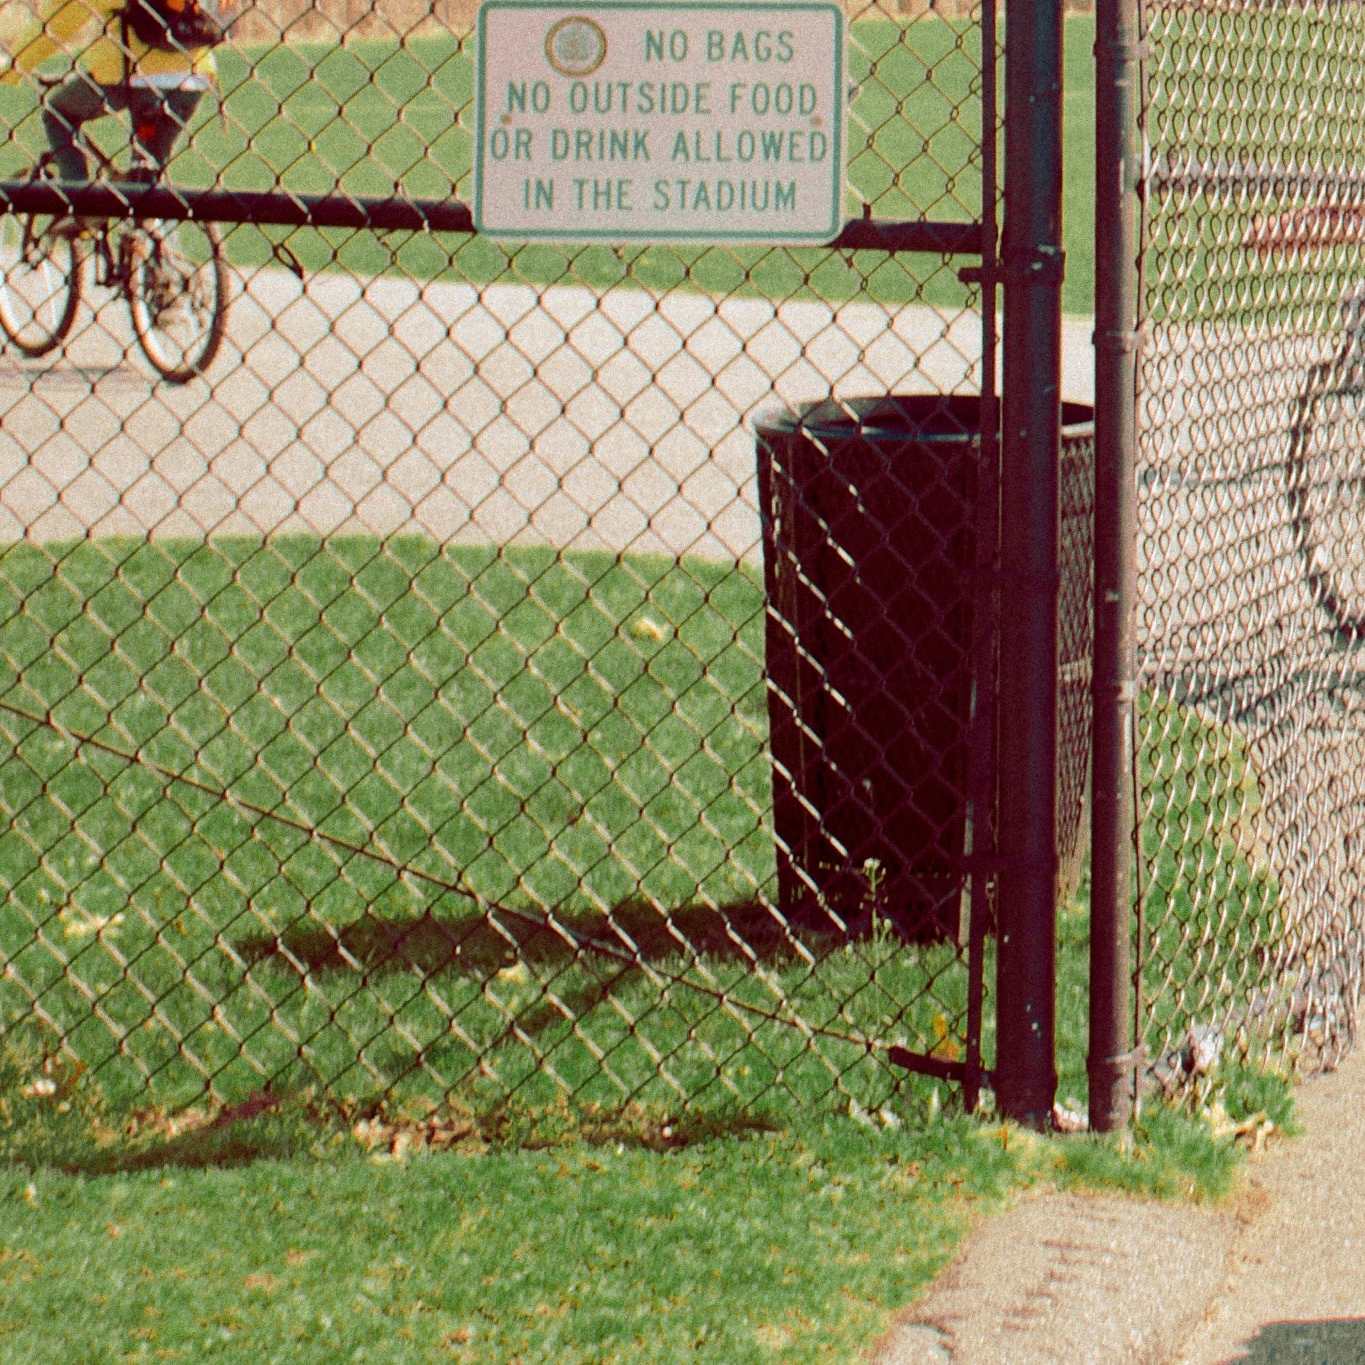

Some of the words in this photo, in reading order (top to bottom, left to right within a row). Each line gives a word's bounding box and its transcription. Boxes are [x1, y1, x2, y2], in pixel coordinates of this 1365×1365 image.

[645, 29, 688, 63] NO
[707, 30, 795, 64] BAGS
[507, 80, 551, 114] NO
[569, 81, 711, 115] OUTSIDE
[729, 82, 817, 116] FOOD
[489, 128, 532, 161] OR
[551, 129, 650, 162] DRINK
[672, 130, 828, 163] ALLOWED
[523, 178, 553, 210] IN
[573, 179, 634, 211] THE
[652, 179, 797, 212] STADIUM
